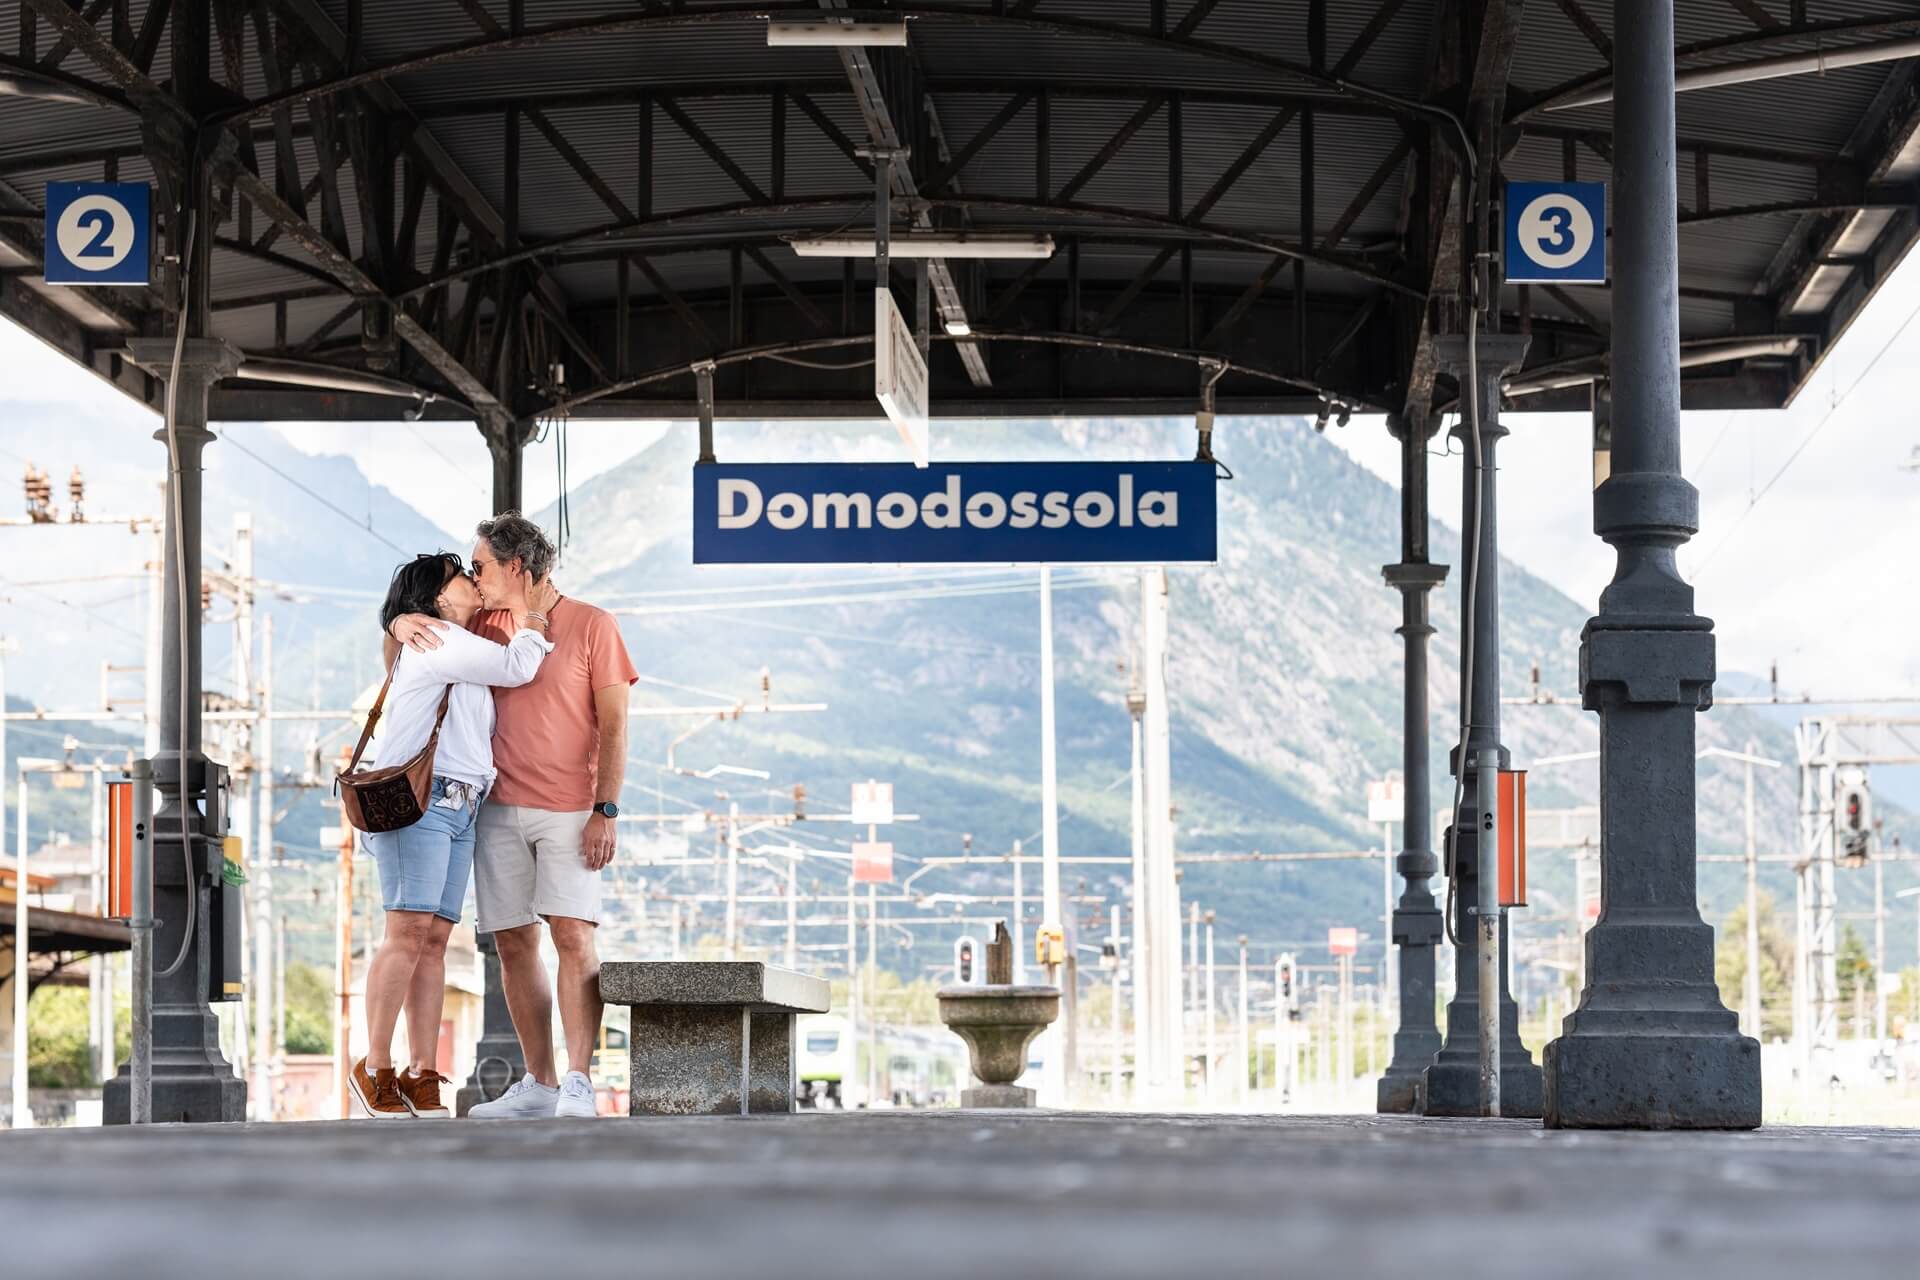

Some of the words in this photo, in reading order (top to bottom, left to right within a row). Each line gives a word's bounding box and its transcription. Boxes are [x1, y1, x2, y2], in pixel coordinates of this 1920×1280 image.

[77, 209, 114, 257] 2
[1537, 207, 1575, 255] 3
[718, 474, 1178, 529] Domodossola
